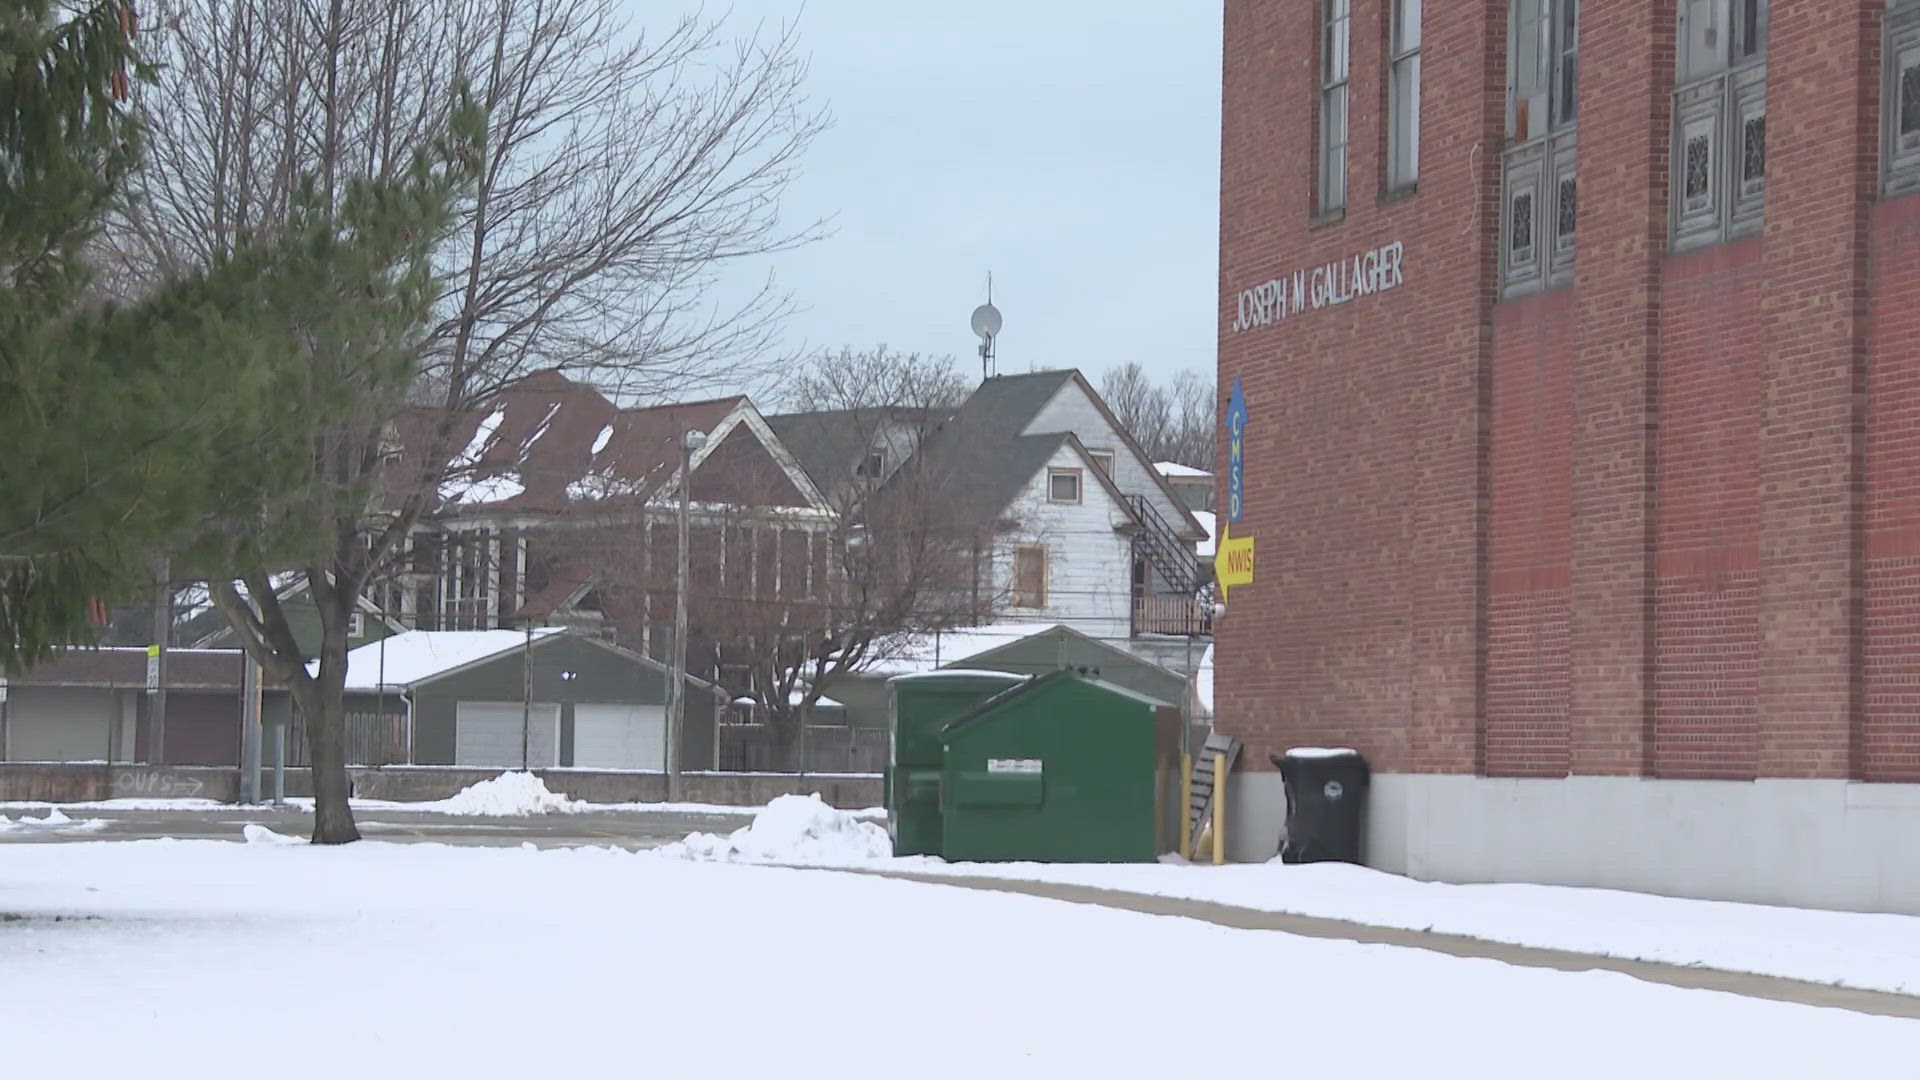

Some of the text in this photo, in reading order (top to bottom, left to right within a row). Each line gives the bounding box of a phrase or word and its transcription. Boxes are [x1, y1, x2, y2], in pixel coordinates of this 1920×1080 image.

[1233, 240, 1403, 332] JOSEPH M GALLAGHER
[1231, 411, 1240, 518] CMSD
[1228, 548, 1252, 574] NWIS
